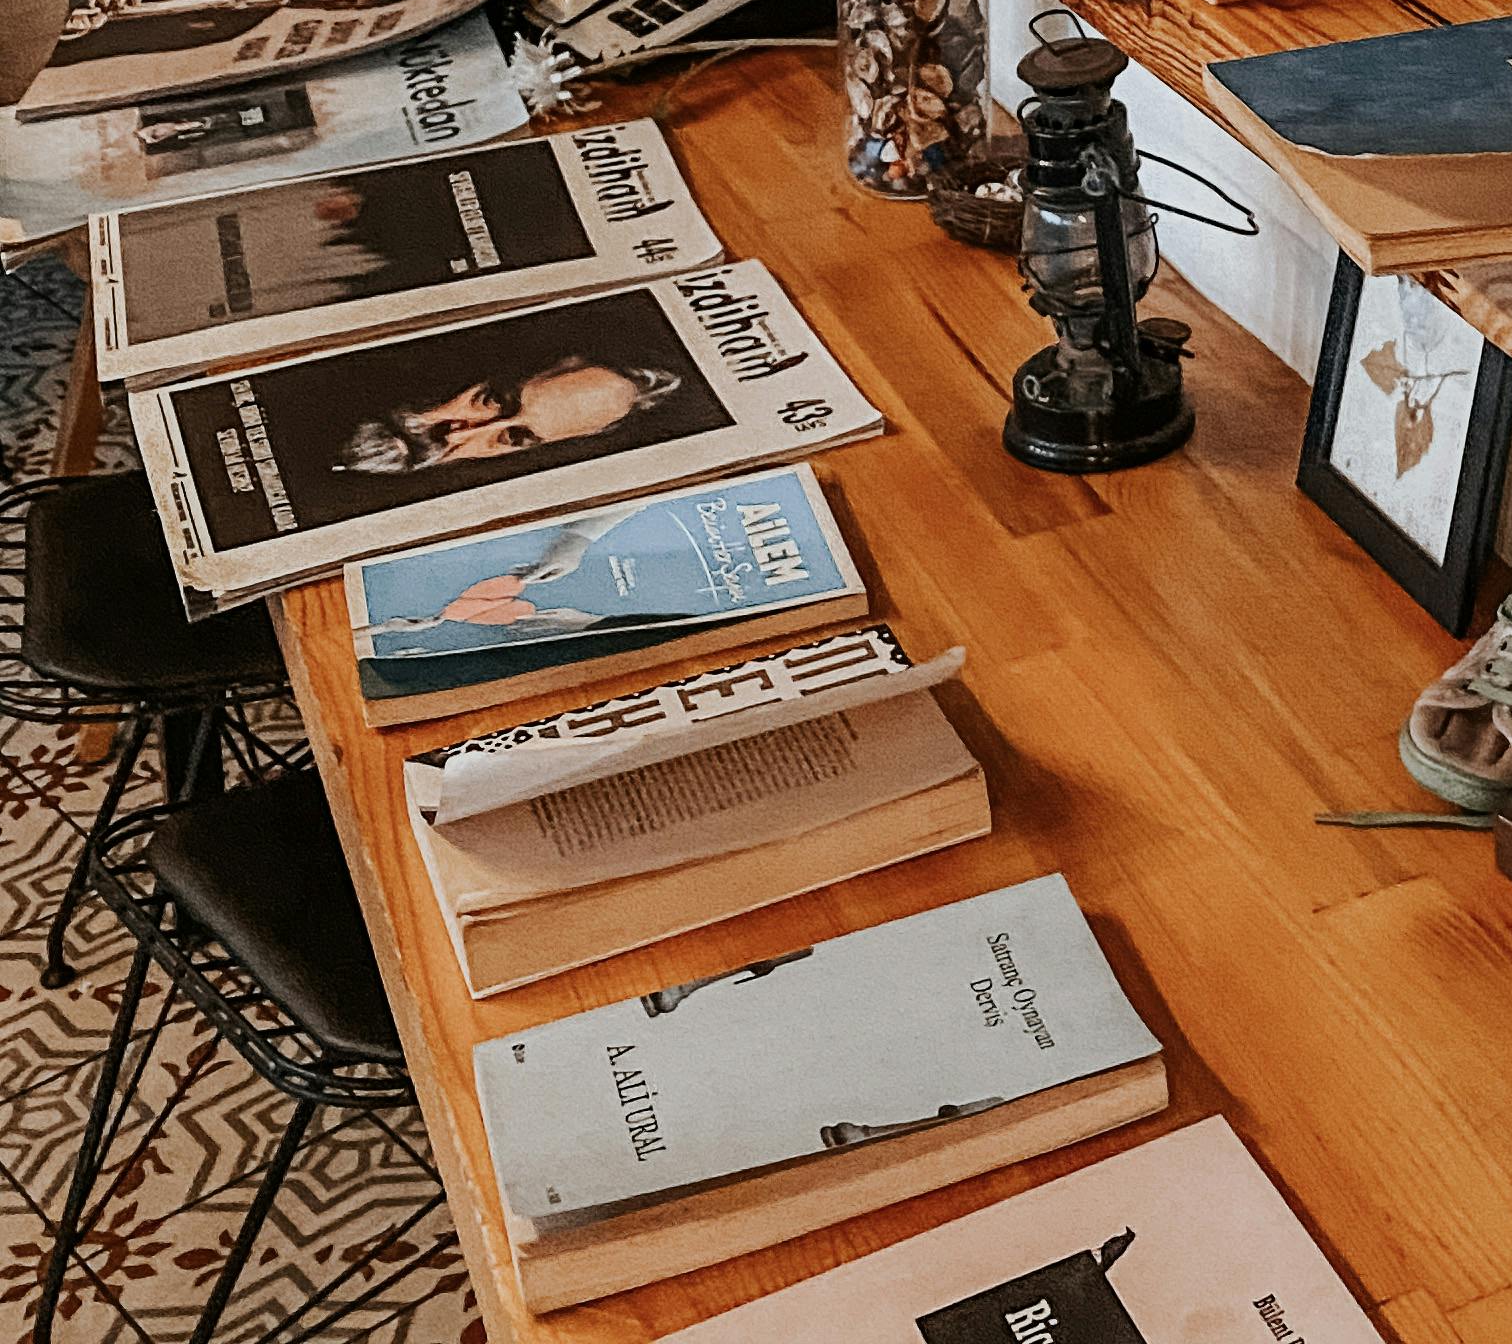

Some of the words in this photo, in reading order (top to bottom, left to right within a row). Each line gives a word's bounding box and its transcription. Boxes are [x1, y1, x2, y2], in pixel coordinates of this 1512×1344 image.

[572, 127, 674, 223] izdiham
[632, 238, 678, 259] 44
[673, 269, 809, 382] izdiham
[777, 398, 832, 424] 43
[969, 978, 1009, 1028] Derviş
[986, 932, 1023, 987] Satranç
[1011, 988, 1056, 1050] Oynayan
[606, 1045, 636, 1066] A.
[613, 1070, 659, 1107] ALİ
[625, 1104, 667, 1162] URAL
[1253, 1293, 1294, 1342] Bülent
